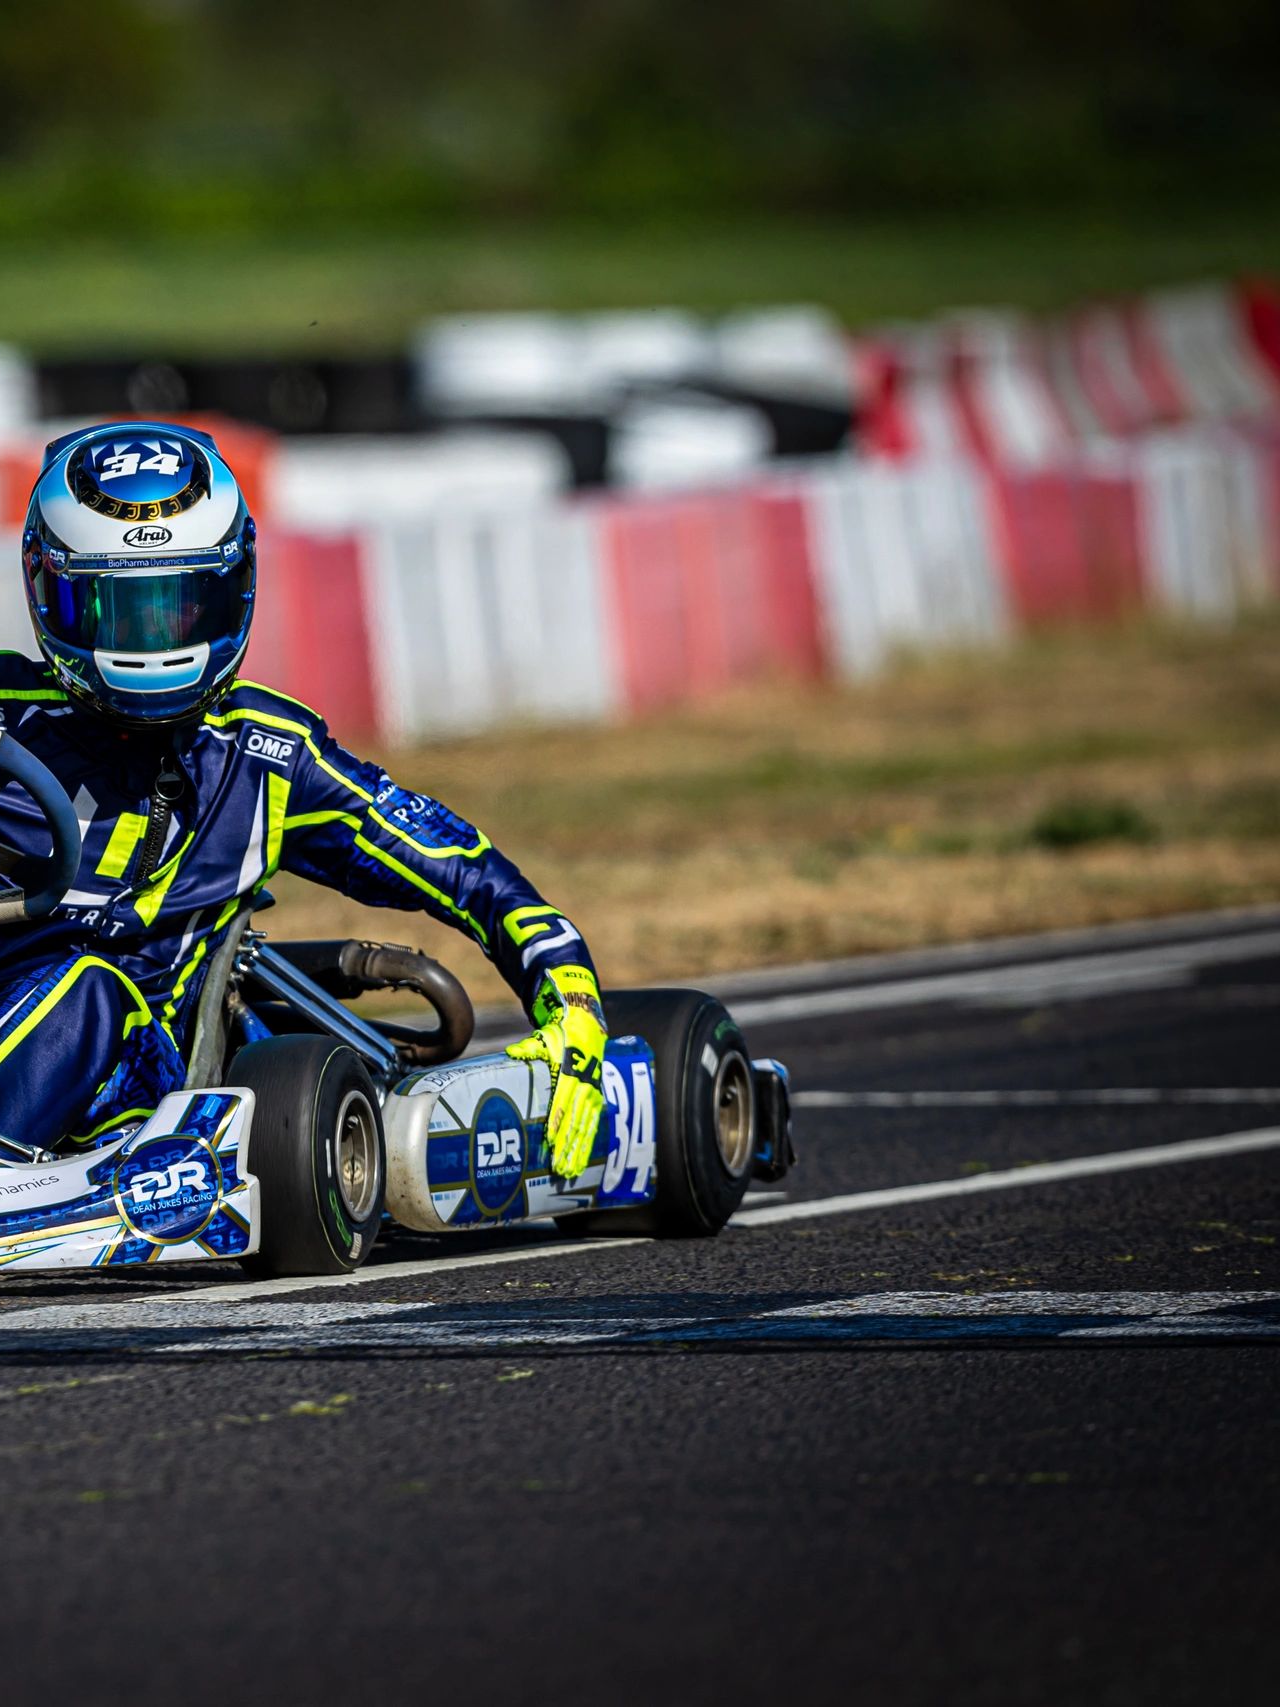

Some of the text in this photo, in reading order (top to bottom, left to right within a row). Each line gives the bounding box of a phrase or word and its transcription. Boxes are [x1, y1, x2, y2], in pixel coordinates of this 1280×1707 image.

[100, 452, 179, 481] 34
[127, 527, 167, 542] Arai
[108, 559, 150, 568] BioPharma
[151, 558, 185, 566] Dynamics
[248, 734, 293, 759] OMP
[602, 1061, 656, 1194] 34
[477, 1128, 522, 1168] DJR
[130, 1161, 210, 1203] DJR
[477, 1168, 490, 1178] DEAN
[505, 1164, 522, 1174] RACING
[133, 1192, 213, 1215] DEAN JUKES RACING
